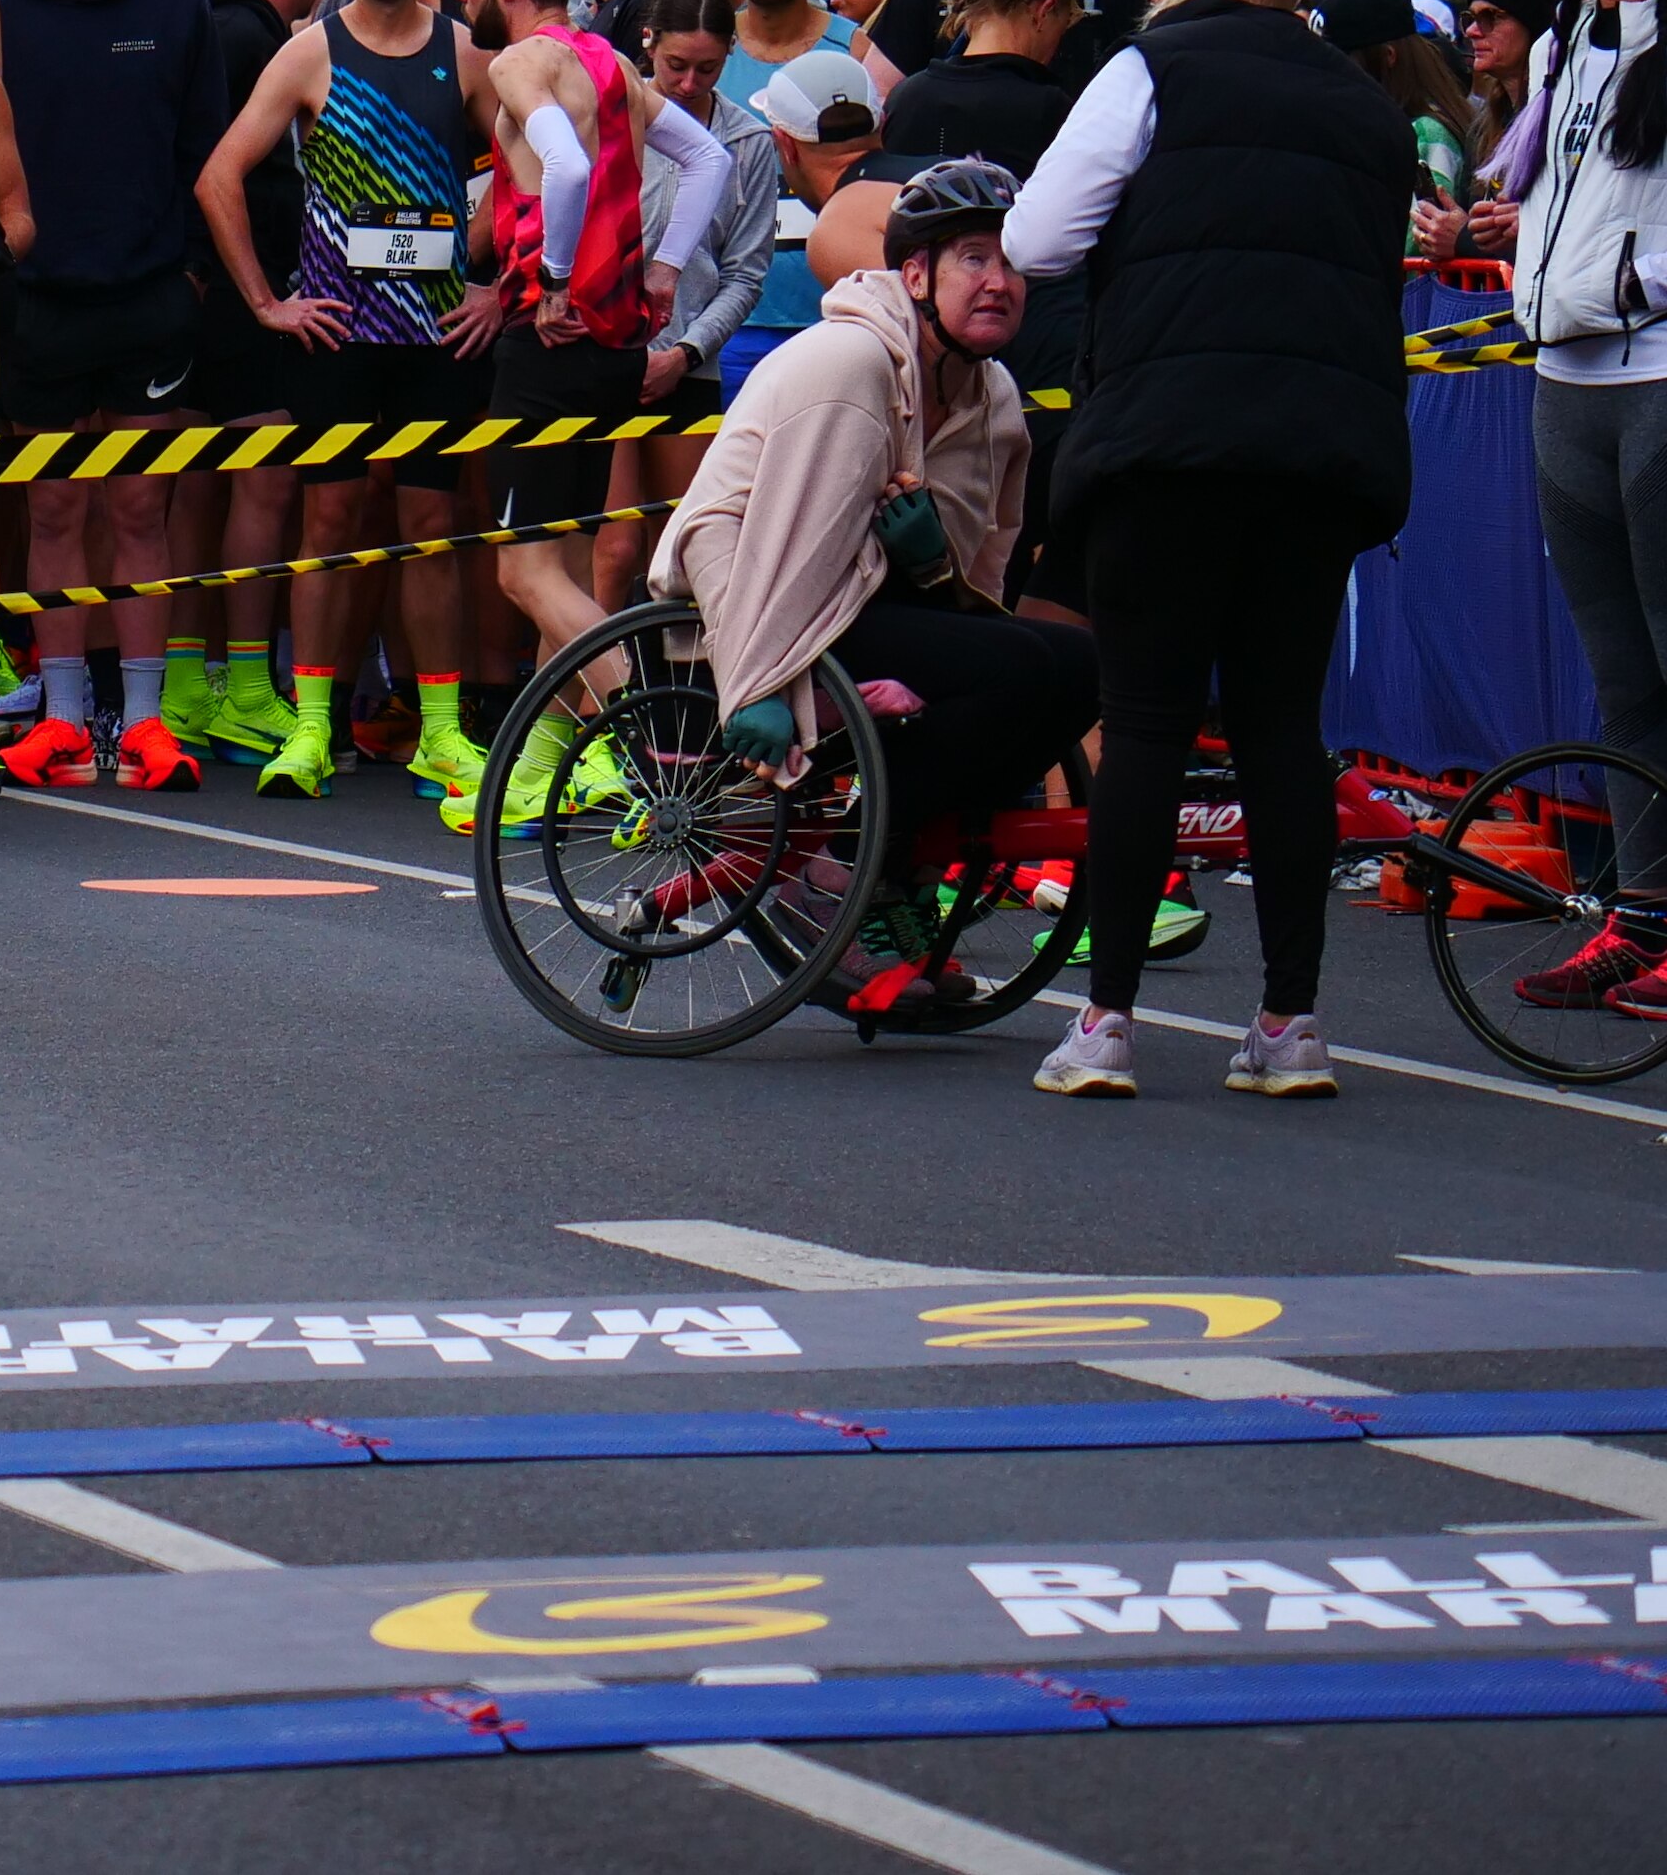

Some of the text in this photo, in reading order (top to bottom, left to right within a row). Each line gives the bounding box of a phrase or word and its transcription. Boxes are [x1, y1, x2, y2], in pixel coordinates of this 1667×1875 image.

[391, 234, 414, 249] 1520
[385, 250, 418, 265] BLAKE
[967, 1546, 1667, 1598] BALL
